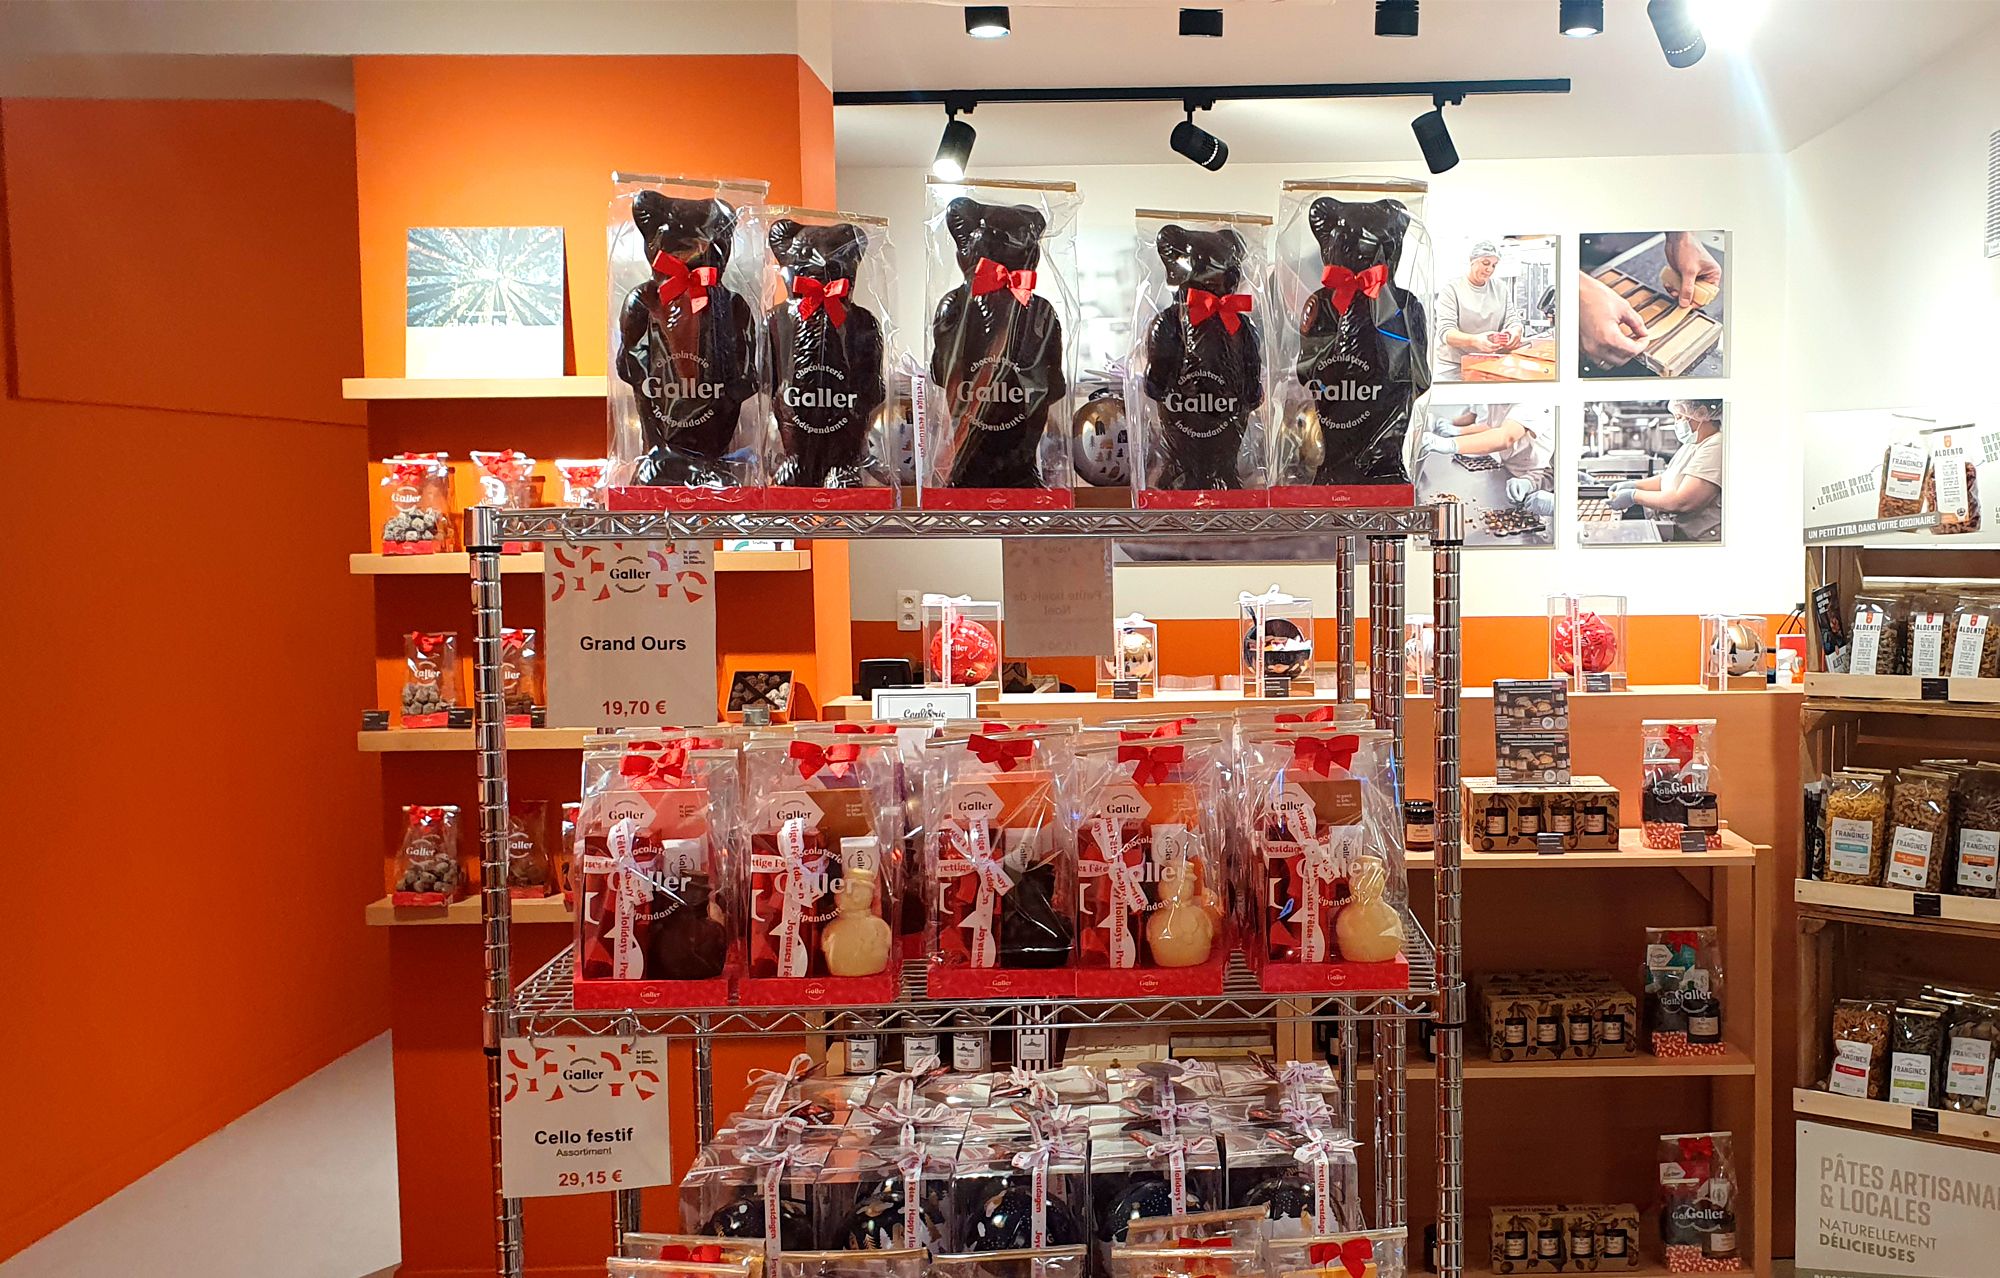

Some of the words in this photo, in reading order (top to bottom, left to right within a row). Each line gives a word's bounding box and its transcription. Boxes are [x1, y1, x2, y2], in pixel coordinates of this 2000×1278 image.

[657, 351, 710, 370] chocolaterie
[1317, 353, 1370, 372] chocolaterie
[795, 363, 845, 381] chocolaterie
[1177, 369, 1226, 386] chocolaterie
[641, 376, 724, 399] Galler
[956, 380, 1034, 403] Galler
[1304, 378, 1383, 401] Galler
[783, 386, 858, 408] Galler
[1165, 392, 1238, 413] Galler
[1934, 447, 1963, 457] ALDENTO
[1858, 473, 1873, 485] PEPS
[391, 493, 422, 503] Galler
[1817, 496, 1826, 506] LE
[1856, 482, 1875, 495] TABLE
[1808, 530, 1818, 539] UN
[1819, 527, 1836, 538] PETIT
[1837, 524, 1858, 535] EXTRA
[1858, 522, 1876, 533] DANS
[1876, 520, 1899, 530] VOTRE
[1899, 515, 1936, 528] ORDINAIRE
[610, 568, 651, 580] Galler
[1856, 623, 1881, 632] ALDENTO
[580, 636, 636, 651] Grand
[641, 635, 687, 651] Ours
[602, 700, 650, 717] 19,70
[656, 700, 667, 715] €
[958, 802, 993, 811] Galler
[1107, 804, 1141, 814] Galler
[608, 810, 645, 820] Galler
[776, 810, 812, 820] Galler
[1835, 830, 1870, 840] FRANGINES
[405, 847, 435, 857] Galler
[1896, 840, 1927, 851] FRANGINES
[1962, 841, 1996, 852] FRANGINES
[940, 863, 971, 873] rettige
[1675, 990, 1712, 1000] Galler
[563, 1069, 604, 1081] Galler
[1894, 1065, 1927, 1076] FRANGINES
[534, 1130, 581, 1144] Cello
[587, 1127, 634, 1142] festif
[558, 1171, 606, 1187] 29,15
[612, 1169, 623, 1182] €
[1820, 1153, 1884, 1190] PÂTES
[1686, 1207, 1724, 1219] Galler
[1820, 1184, 1833, 1209] &
[1840, 1187, 1931, 1226] LOCALES
[909, 1208, 918, 1237] Happy
[1819, 1217, 1938, 1250] NATURELLEMENT
[1819, 1233, 1916, 1263] DÉLICIEUSES
